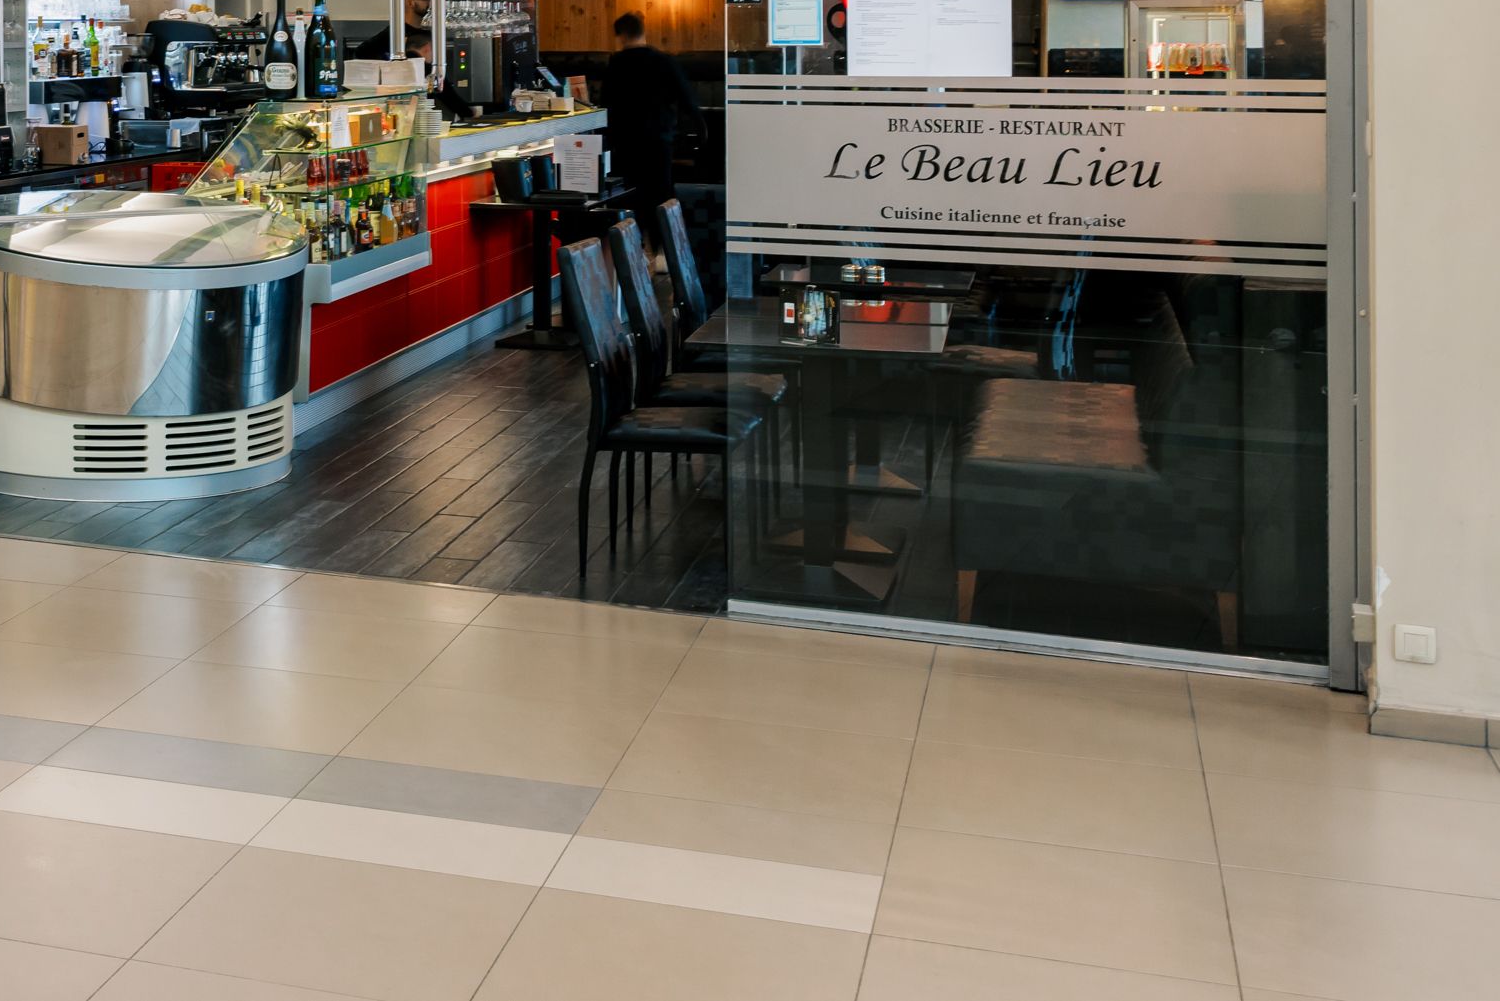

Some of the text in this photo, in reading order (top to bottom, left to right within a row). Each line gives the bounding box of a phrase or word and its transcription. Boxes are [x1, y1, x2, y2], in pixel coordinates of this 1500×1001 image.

[888, 118, 984, 135] BRASSERIE
[999, 120, 1126, 137] RESTAURANT
[824, 142, 1163, 189] Le Beau Lieu
[880, 206, 1126, 230] Cuisine italienne et française
